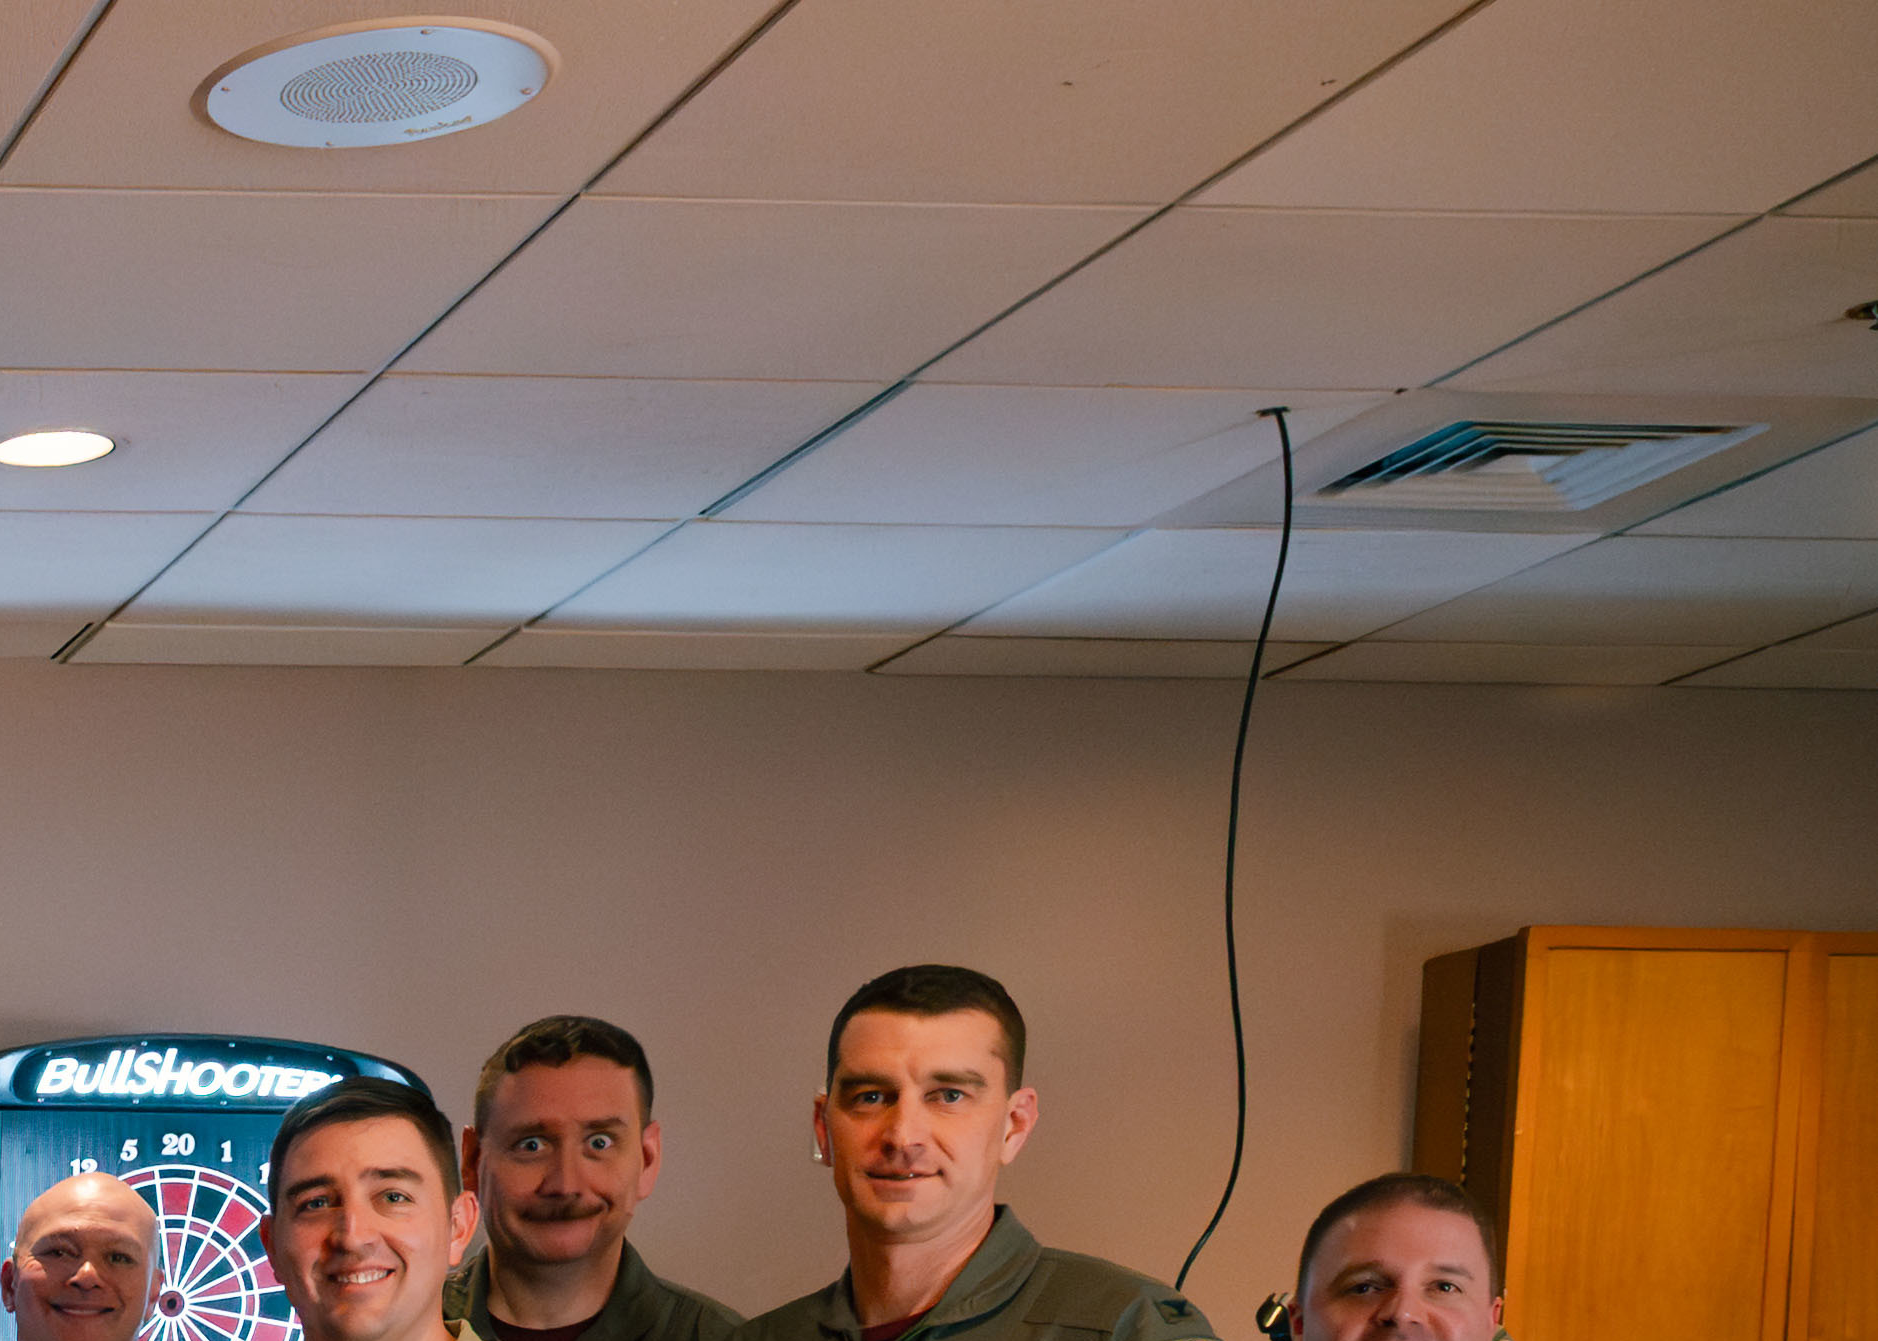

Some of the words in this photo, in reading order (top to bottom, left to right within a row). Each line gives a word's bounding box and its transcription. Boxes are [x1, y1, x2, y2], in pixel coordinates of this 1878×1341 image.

[119, 1138, 139, 1162] 5
[161, 1133, 196, 1156] 20
[220, 1140, 233, 1163] 1
